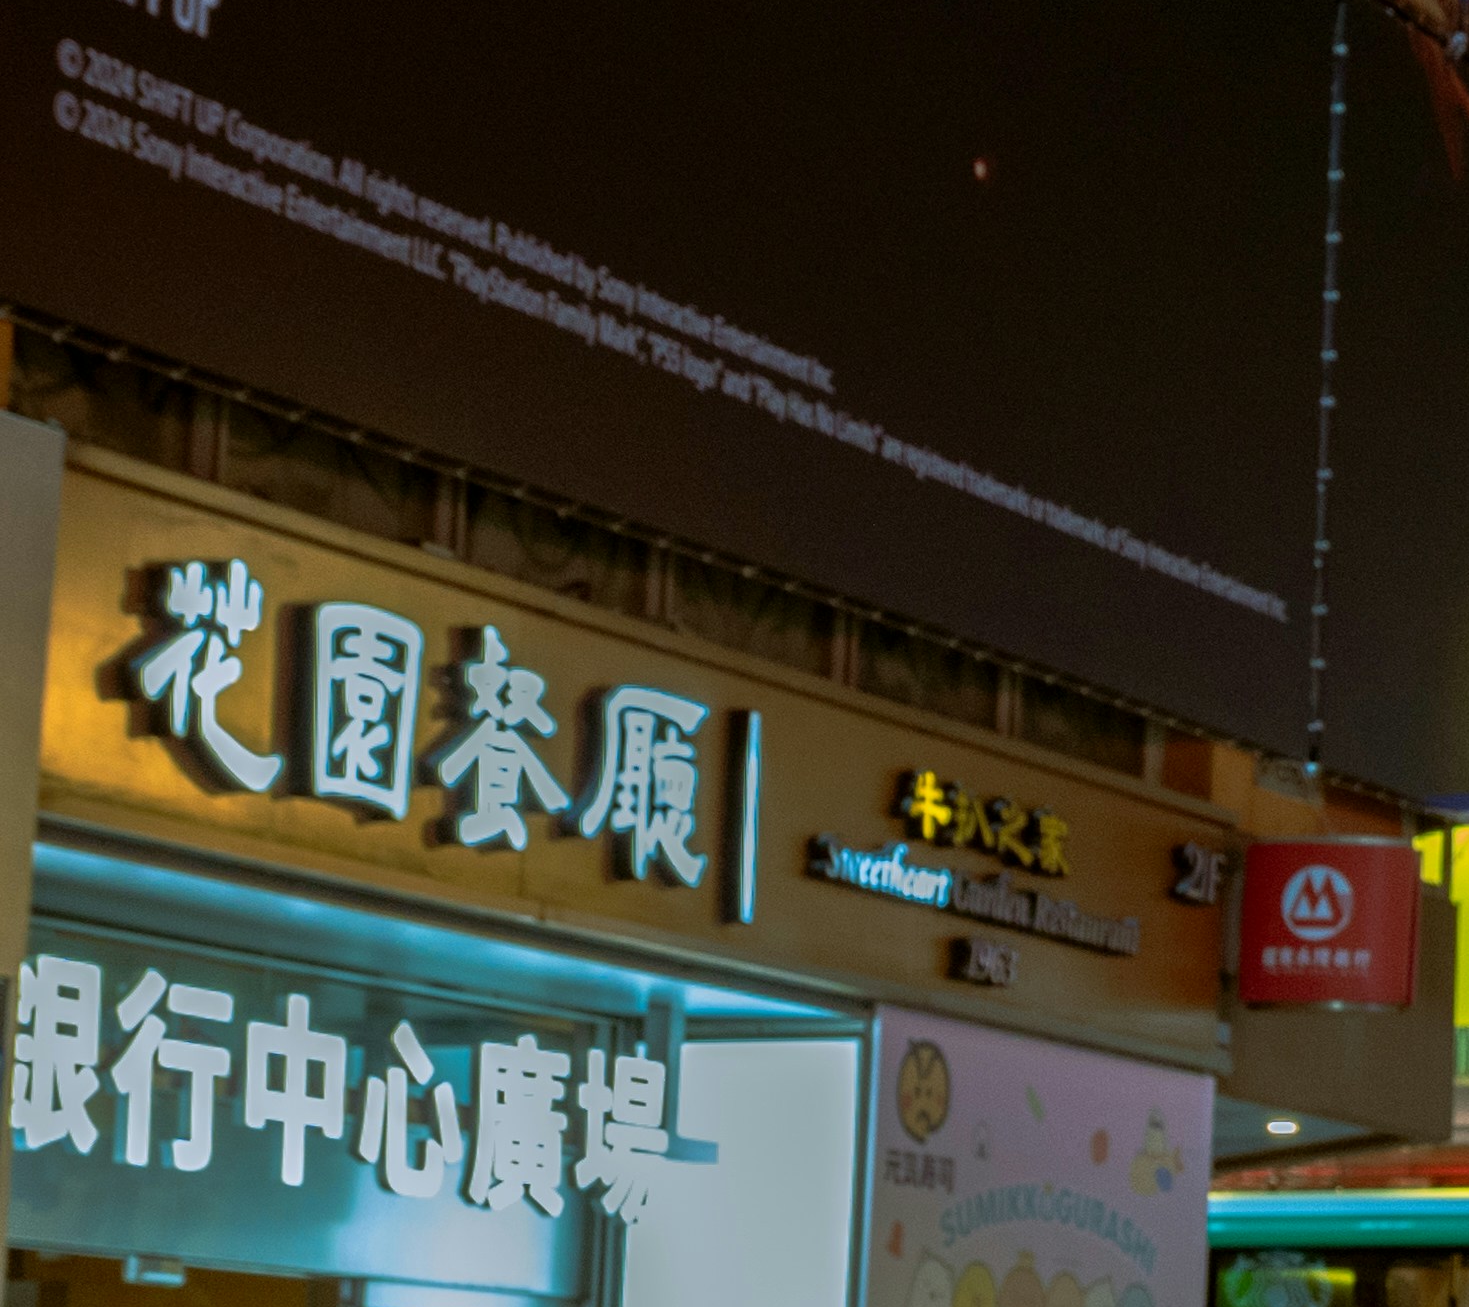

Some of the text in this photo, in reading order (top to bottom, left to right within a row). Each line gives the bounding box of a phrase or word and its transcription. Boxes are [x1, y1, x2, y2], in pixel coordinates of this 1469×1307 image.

[142, 558, 708, 887] 花園餐廳
[822, 830, 953, 909] Sweetheart
